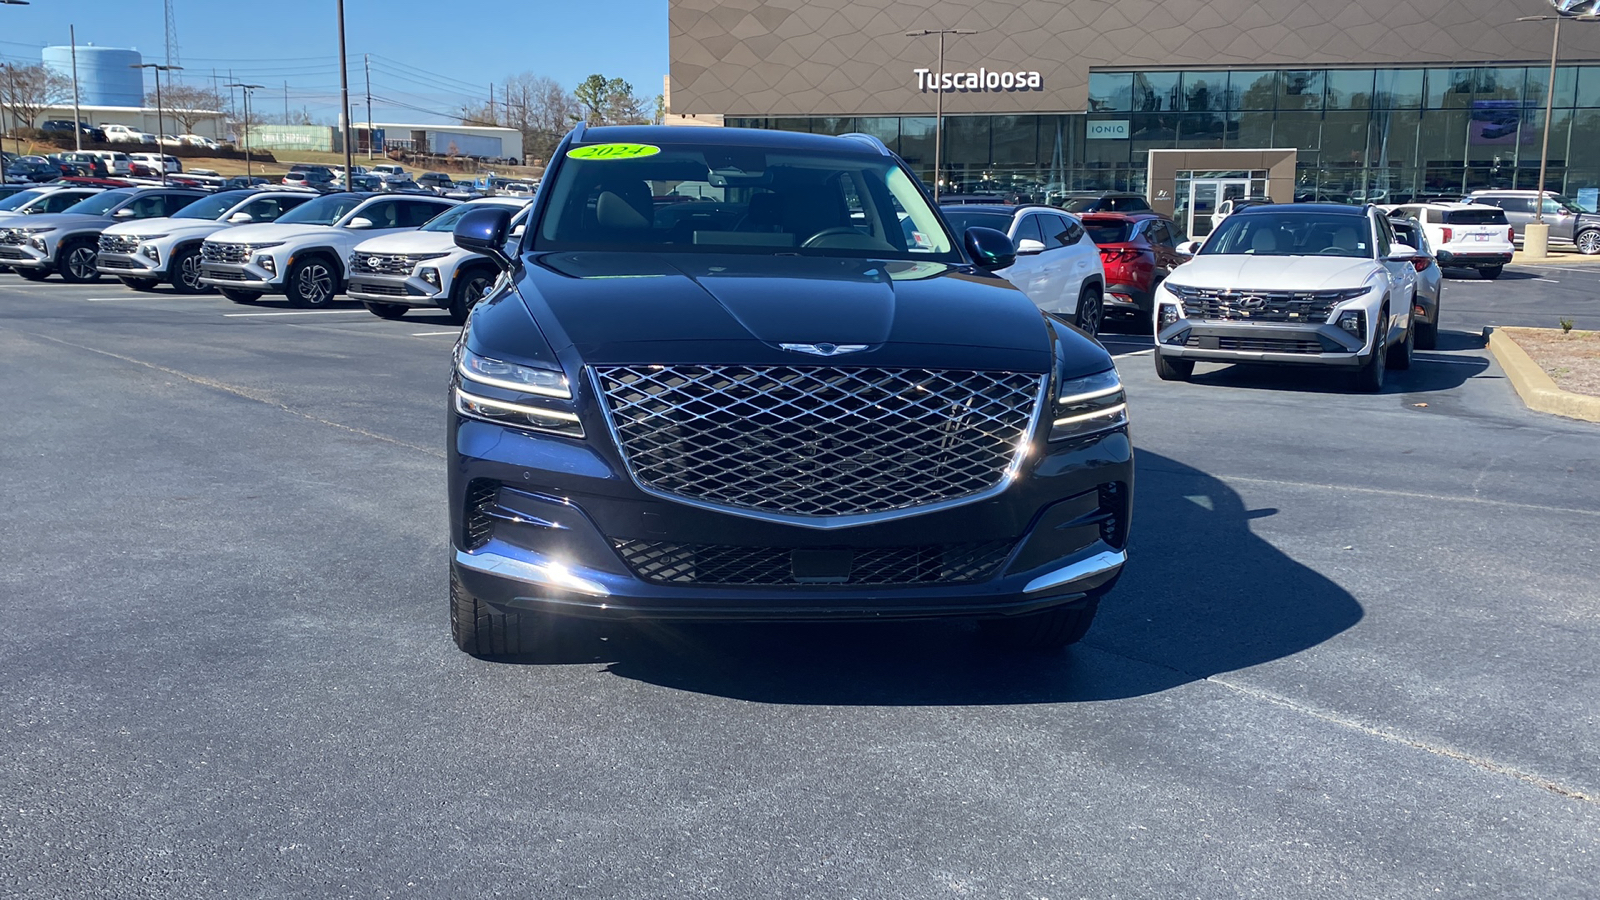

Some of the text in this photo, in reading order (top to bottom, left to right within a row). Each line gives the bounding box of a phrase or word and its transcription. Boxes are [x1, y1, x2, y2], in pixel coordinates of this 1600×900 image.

[913, 67, 1041, 90] Tuscaloosa
[1091, 125, 1124, 134] IONIQ
[581, 146, 646, 158] 2024
